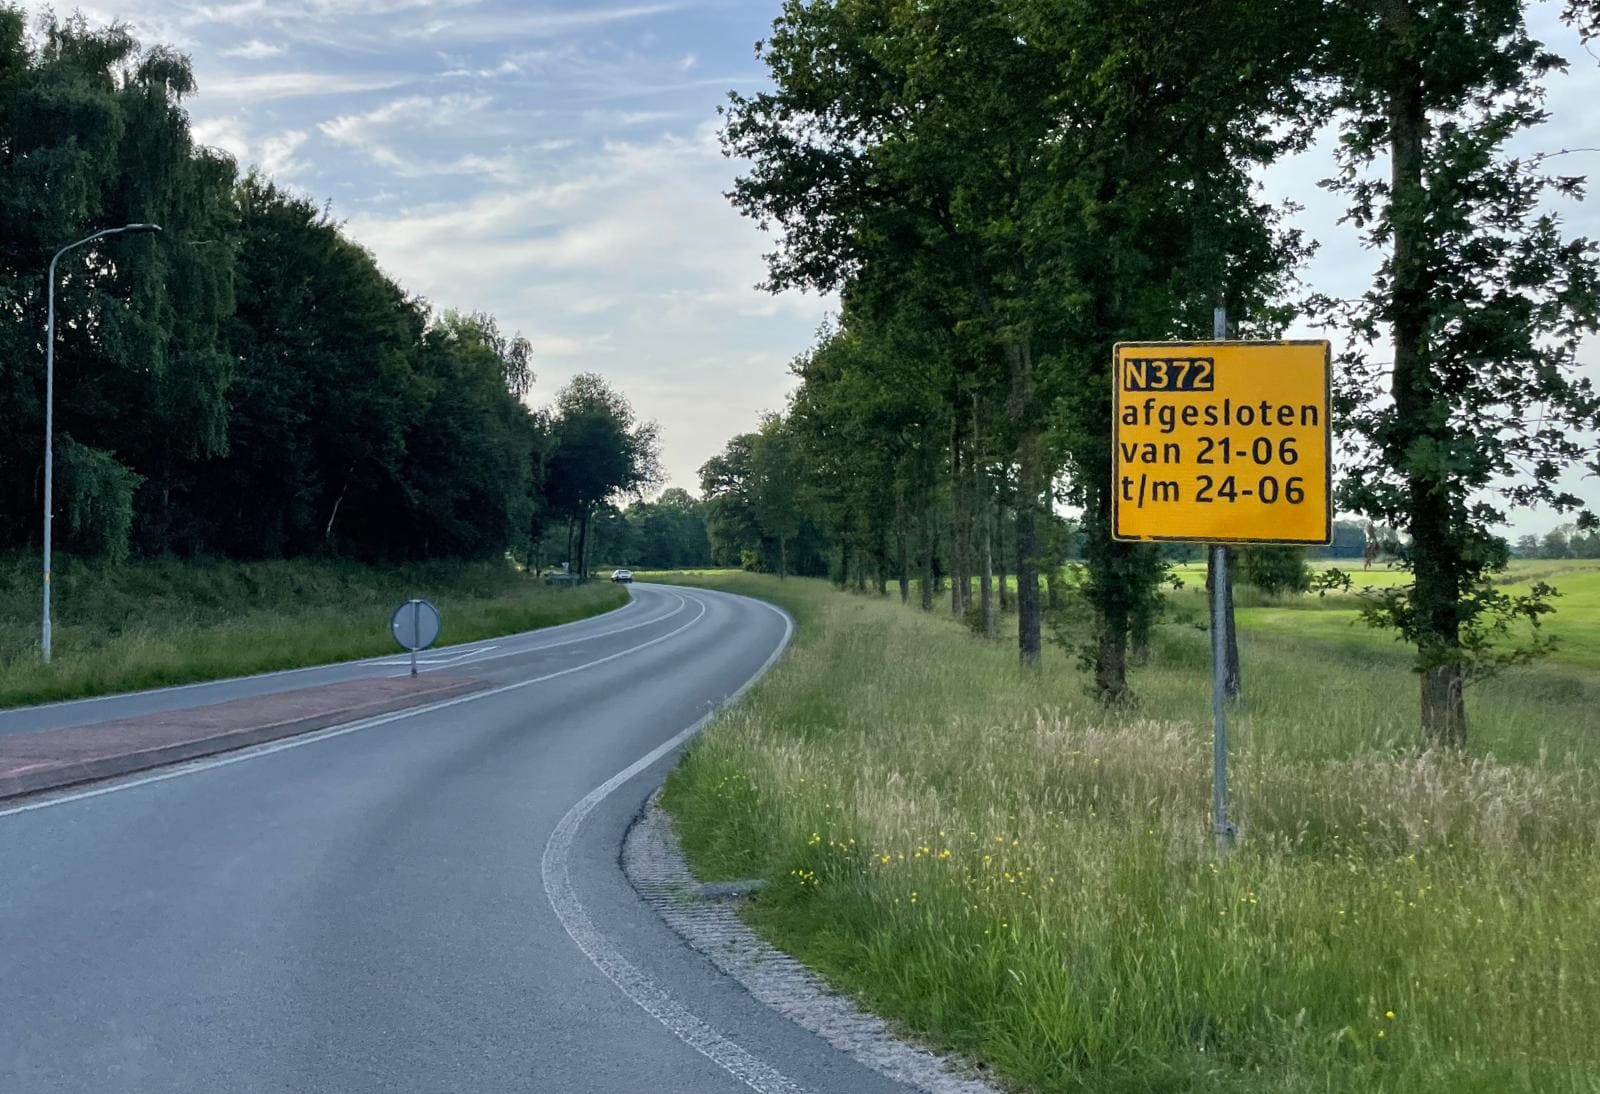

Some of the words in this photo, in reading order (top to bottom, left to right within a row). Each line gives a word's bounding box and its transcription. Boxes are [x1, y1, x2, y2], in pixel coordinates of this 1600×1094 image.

[1125, 360, 1212, 388] N372
[1122, 398, 1318, 433] afgesloten
[1121, 442, 1181, 464] van
[1196, 436, 1298, 465] 21-06
[1121, 473, 1180, 508] t/m
[1195, 475, 1305, 504] 24-06
